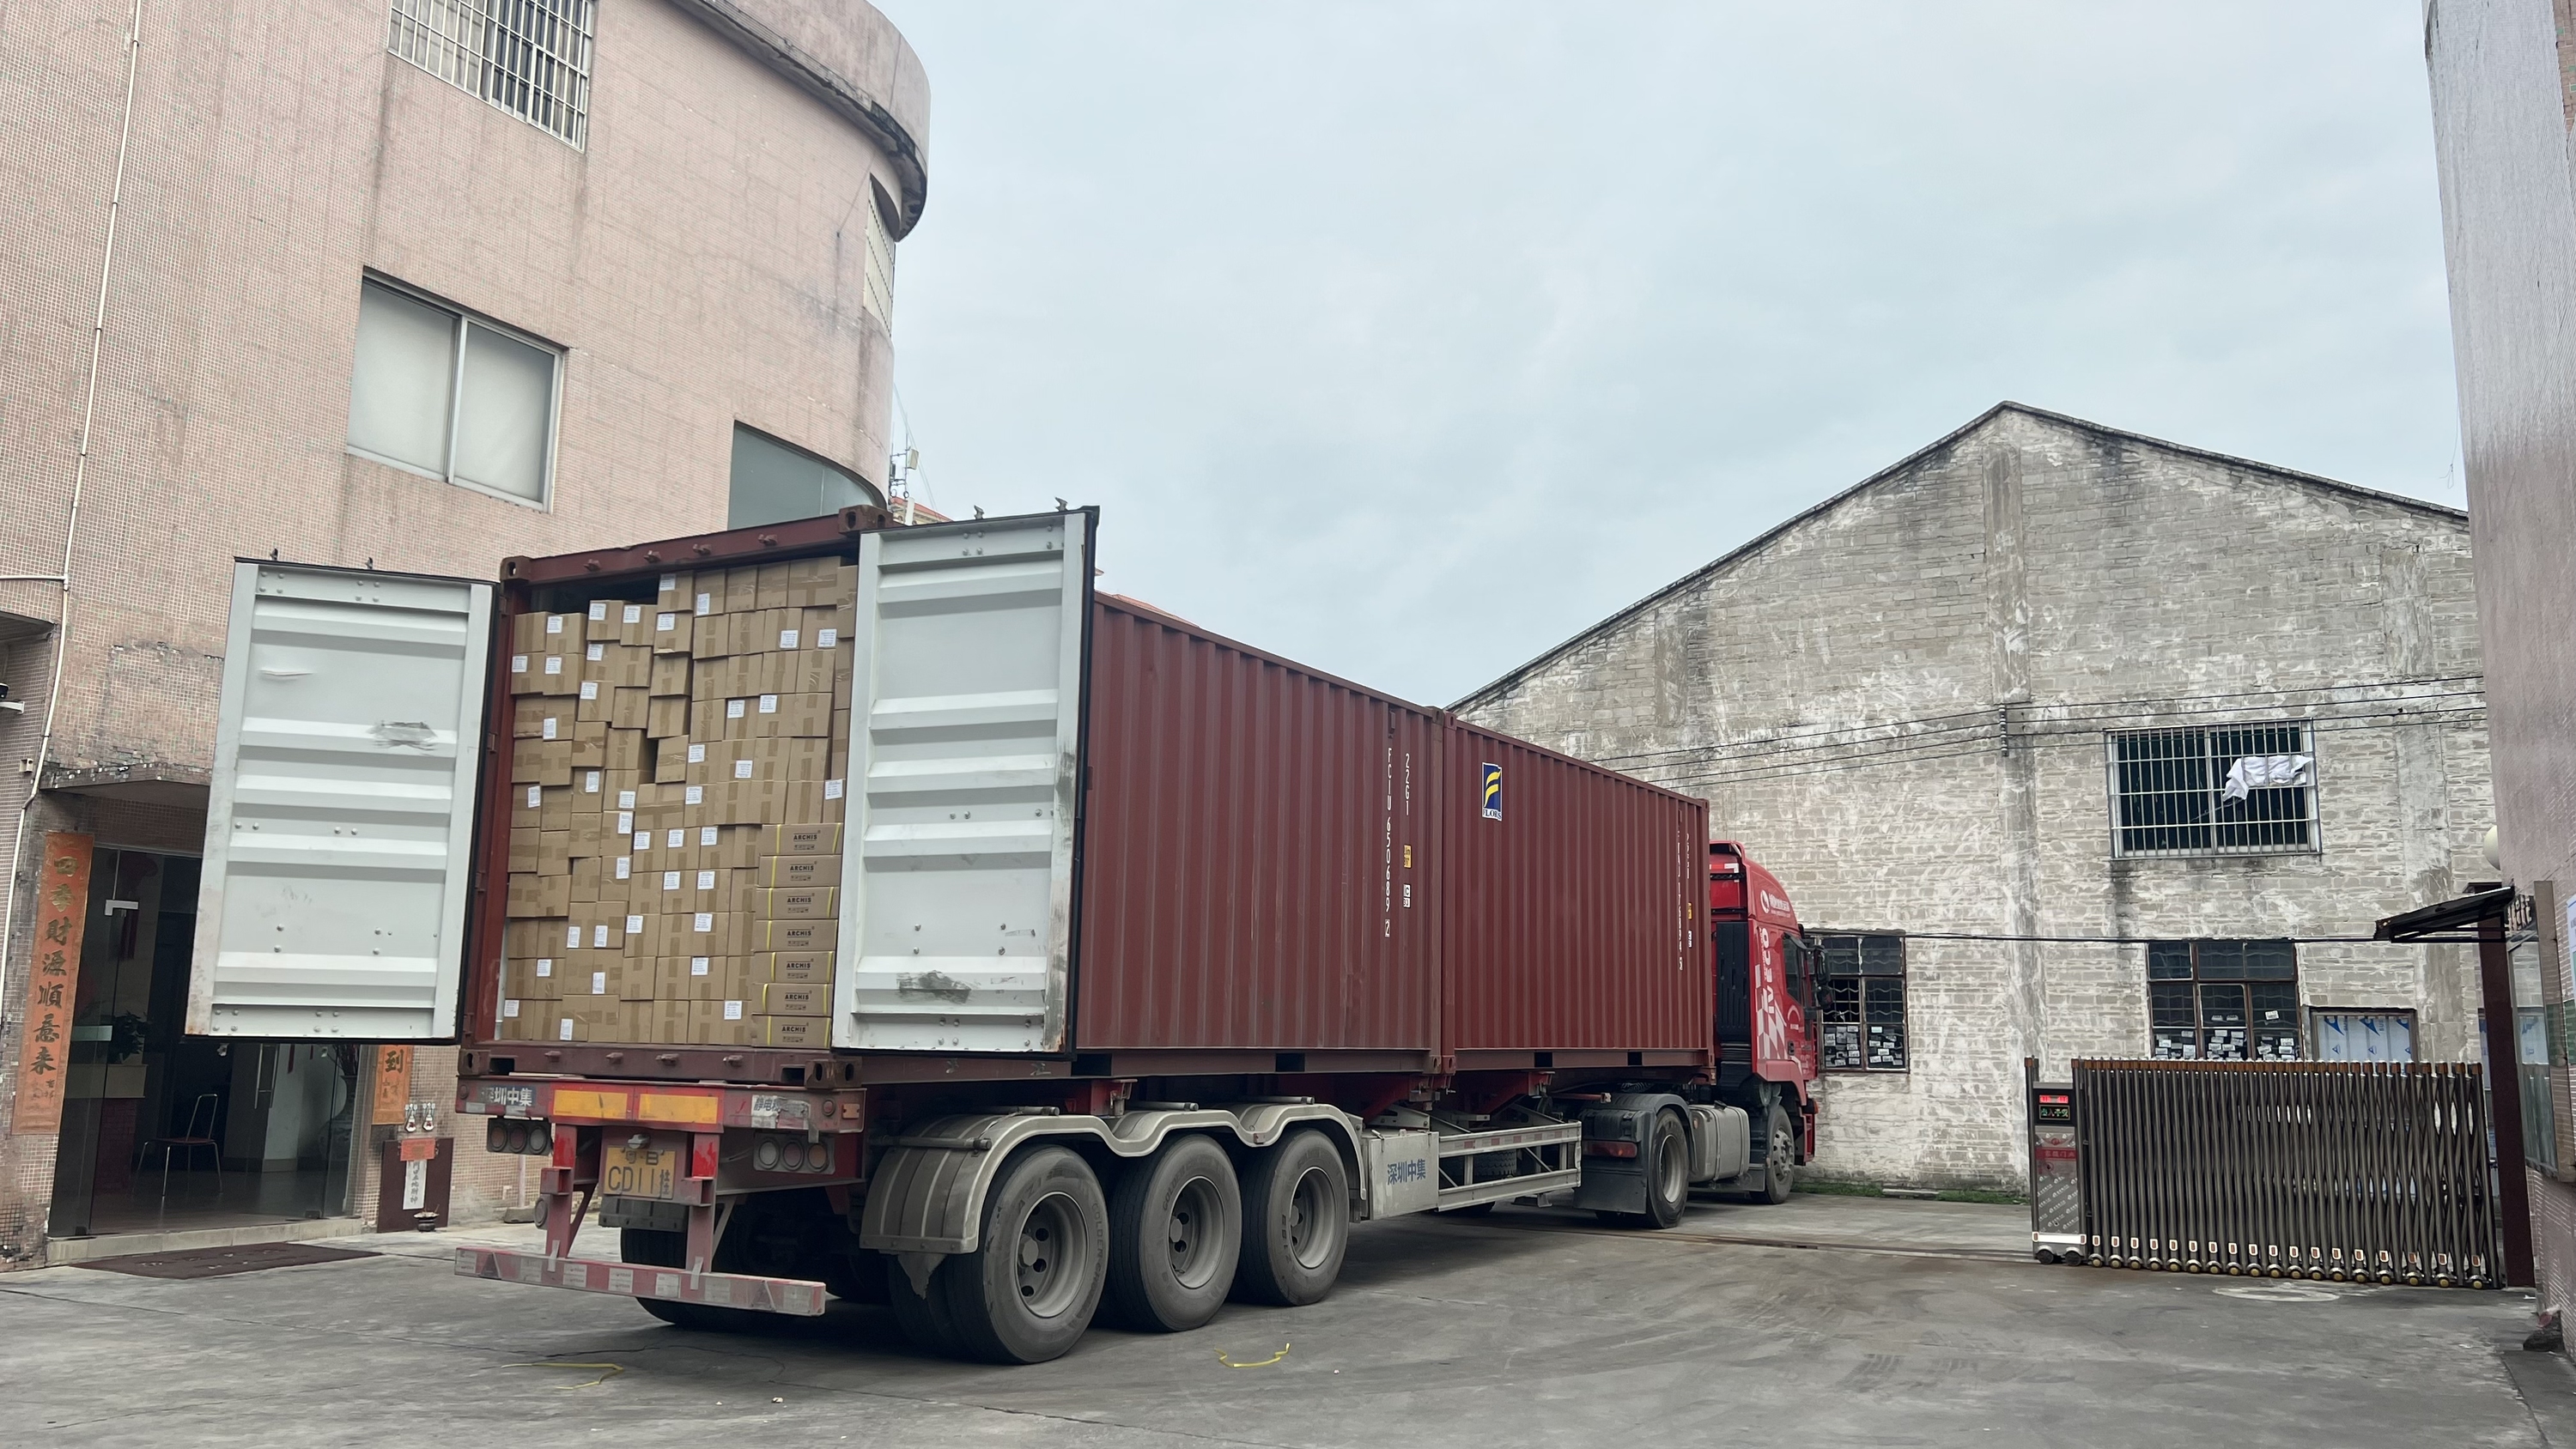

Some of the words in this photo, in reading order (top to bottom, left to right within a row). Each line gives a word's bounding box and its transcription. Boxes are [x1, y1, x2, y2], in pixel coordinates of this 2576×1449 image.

[1761, 928, 1775, 1014] IVECO
[1387, 1157, 1426, 1185] 深圳中集
